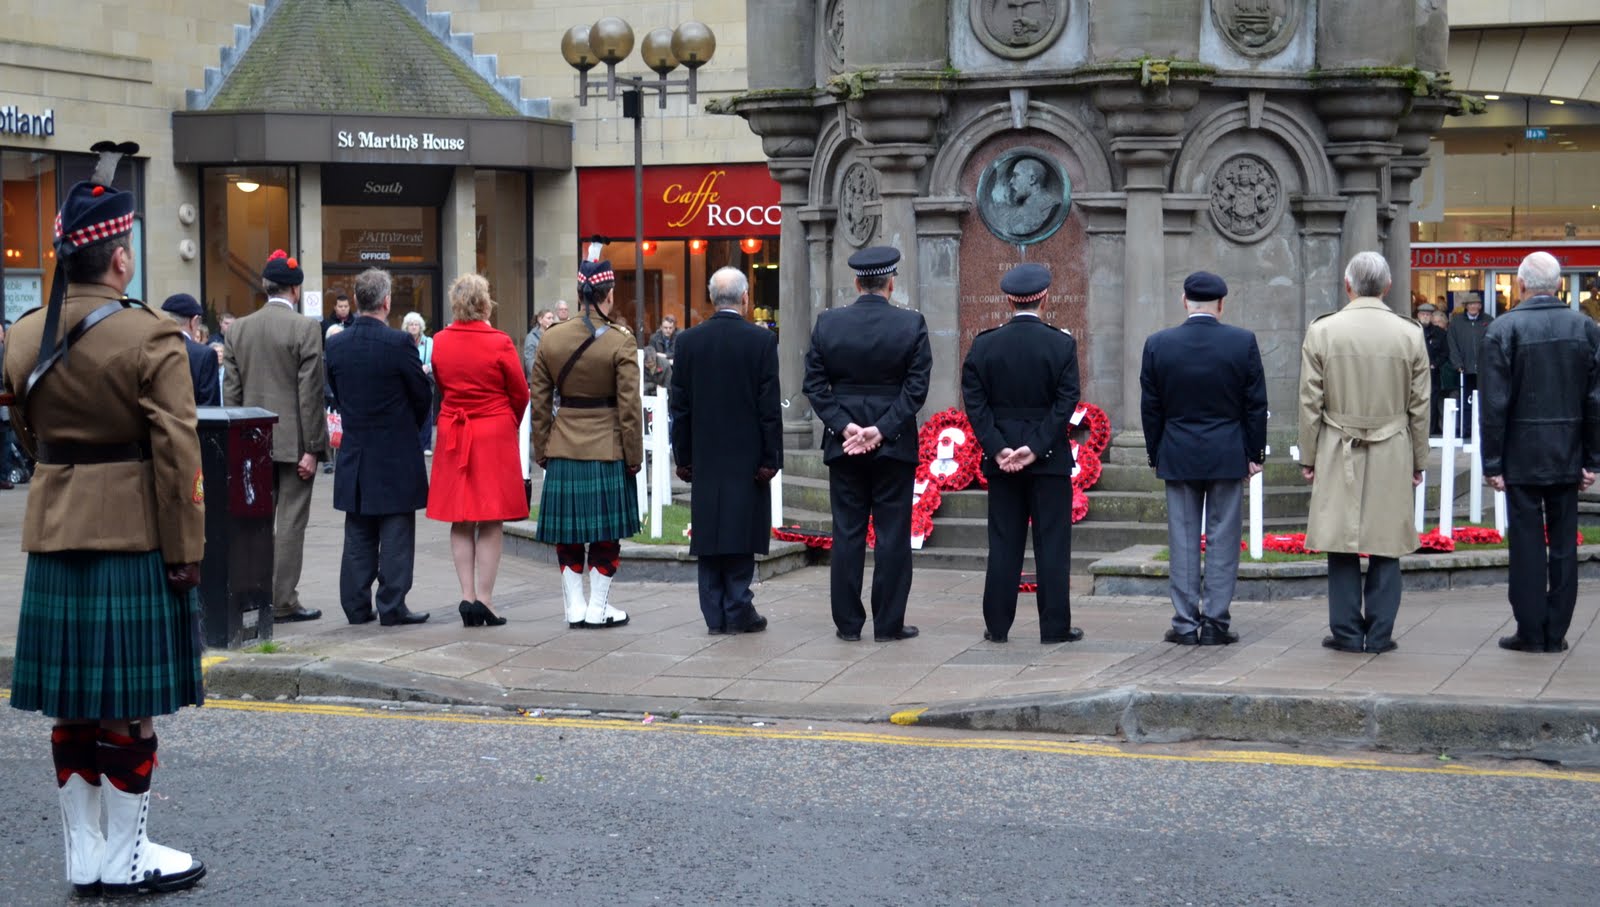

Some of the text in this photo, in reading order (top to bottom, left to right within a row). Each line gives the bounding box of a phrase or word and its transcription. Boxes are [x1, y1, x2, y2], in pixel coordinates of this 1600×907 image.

[338, 130, 465, 151] St Martin's House
[363, 181, 403, 194] South
[663, 170, 726, 228] Caffe
[361, 252, 391, 260] OFFICES
[1415, 249, 1471, 267] John's
